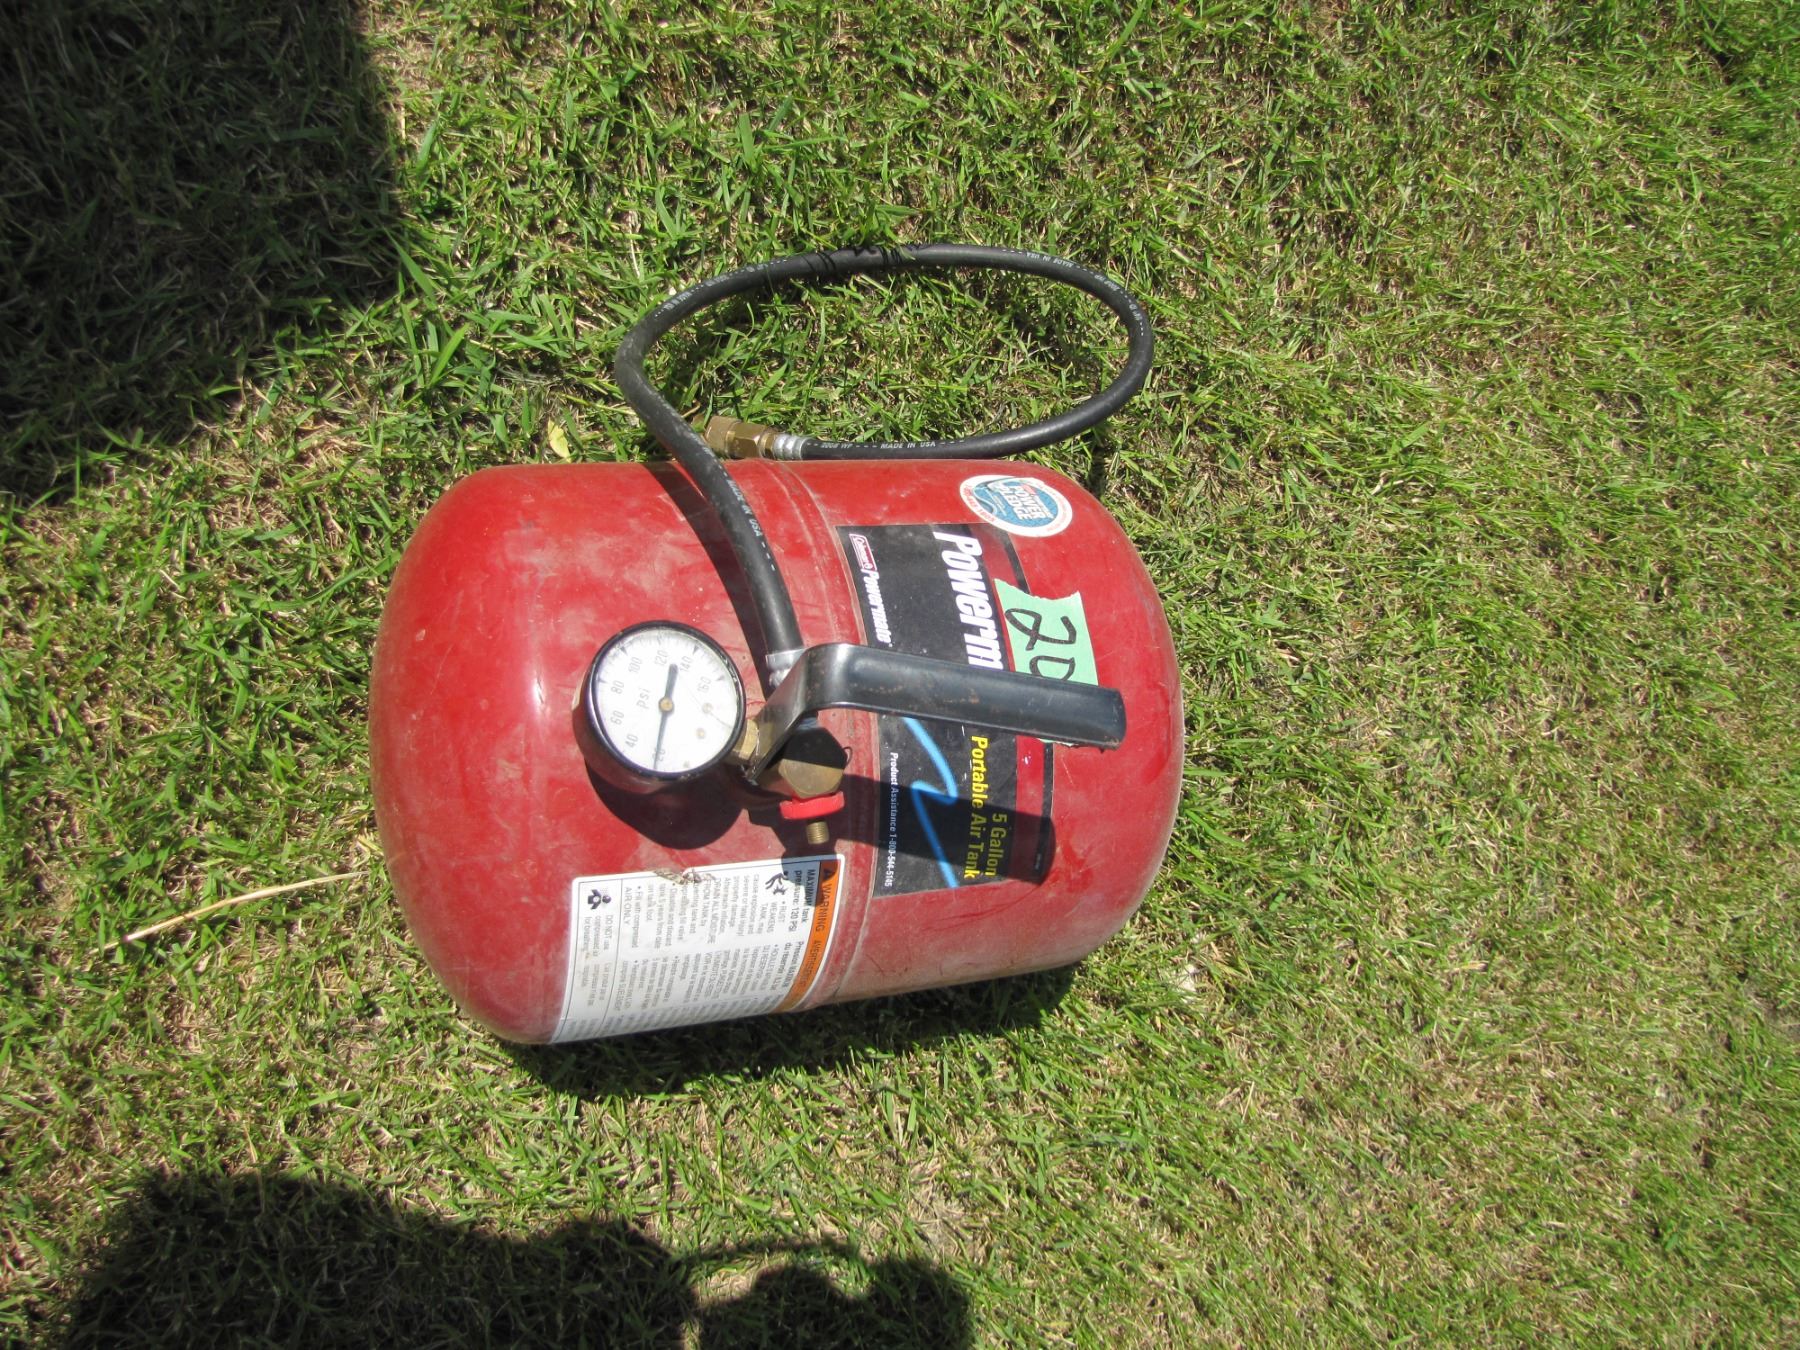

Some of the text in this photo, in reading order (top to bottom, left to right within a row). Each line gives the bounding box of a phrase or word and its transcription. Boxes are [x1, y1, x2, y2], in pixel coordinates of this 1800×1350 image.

[1053, 258, 1074, 268] MADE
[727, 479, 762, 537] MADE IN USA
[861, 569, 889, 643] Powermate
[933, 531, 1004, 671] Powerm
[628, 656, 643, 673] 100
[654, 649, 669, 666] 120
[679, 655, 693, 672] 140
[611, 680, 624, 694] 80
[636, 687, 651, 709] psi
[610, 709, 625, 725] 60
[625, 733, 638, 748] 40
[889, 752, 899, 785] Product
[889, 787, 898, 831] Assistance
[964, 735, 989, 879] Portable Air Tank
[985, 813, 1007, 877] 5 Gallon
[624, 887, 632, 925] AIR ONLY
[712, 900, 720, 911] ALL
[789, 870, 802, 932] pressure: 120 PSI
[801, 869, 816, 923] MAXIMUM tank
[701, 901, 710, 918] TANK
[815, 883, 833, 932] WARNING
[605, 915, 613, 924] DO
[604, 925, 613, 939] NOT
